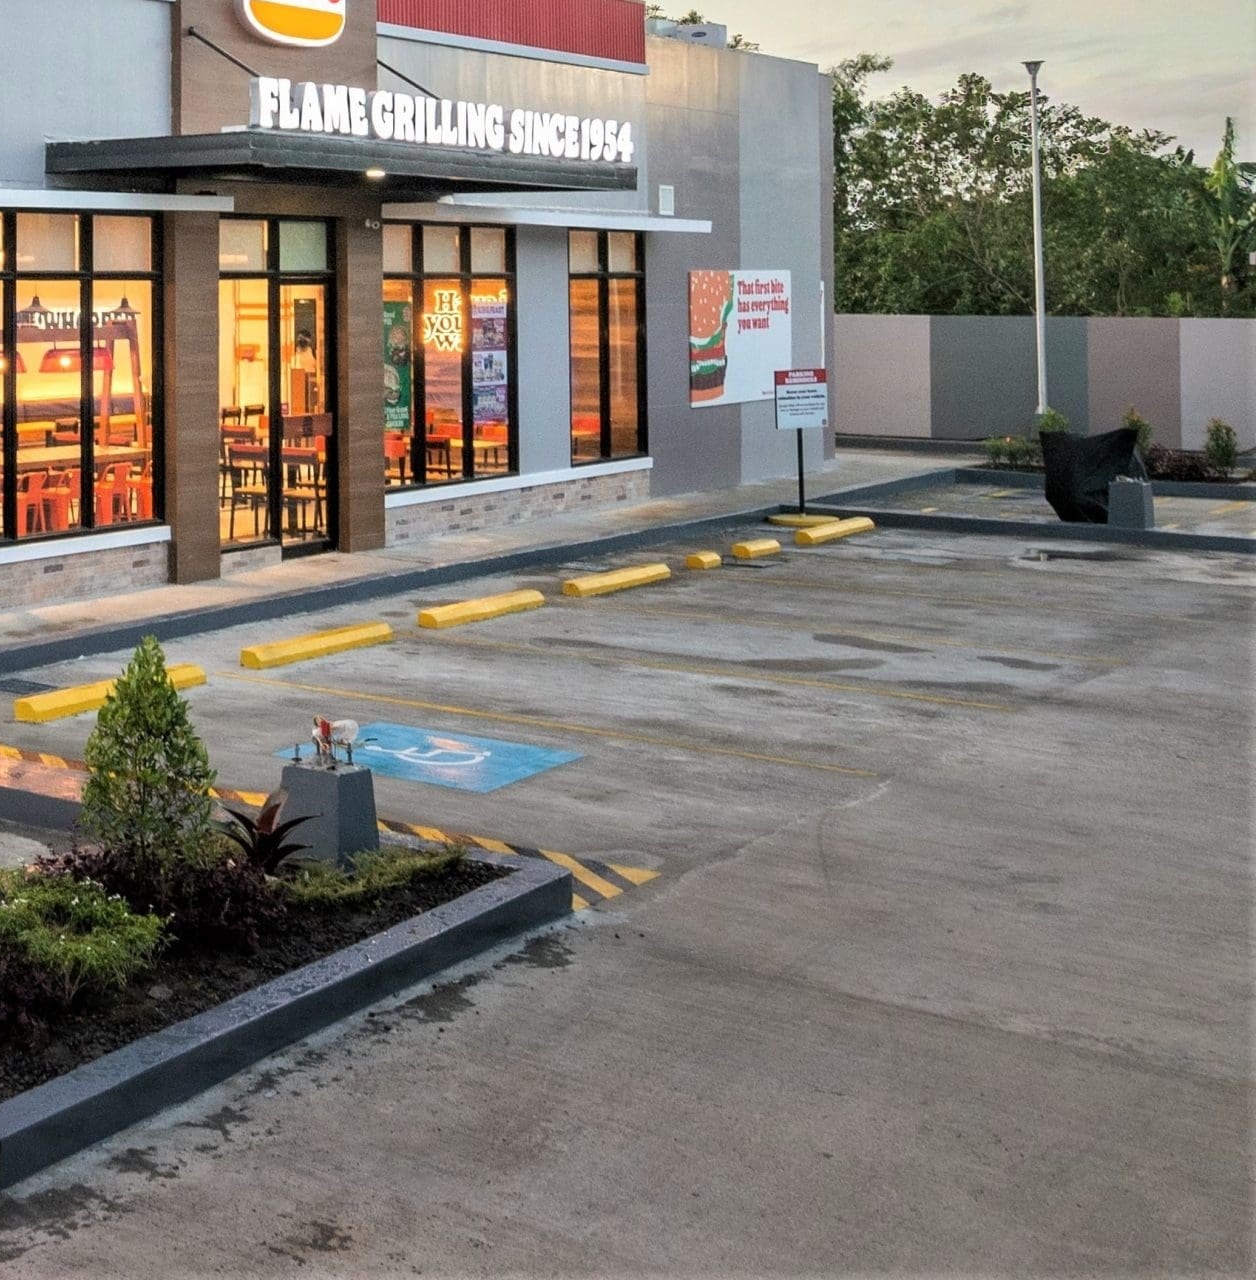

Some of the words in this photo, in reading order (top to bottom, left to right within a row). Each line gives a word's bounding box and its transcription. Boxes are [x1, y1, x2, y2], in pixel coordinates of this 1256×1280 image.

[257, 77, 369, 136] FLAME
[371, 90, 505, 150] GRILLING
[738, 280, 754, 295] That
[755, 278, 770, 295] first
[771, 278, 784, 294] bite
[738, 297, 750, 313] has
[751, 296, 789, 315] everything
[738, 319, 751, 334] you
[752, 317, 770, 329] want
